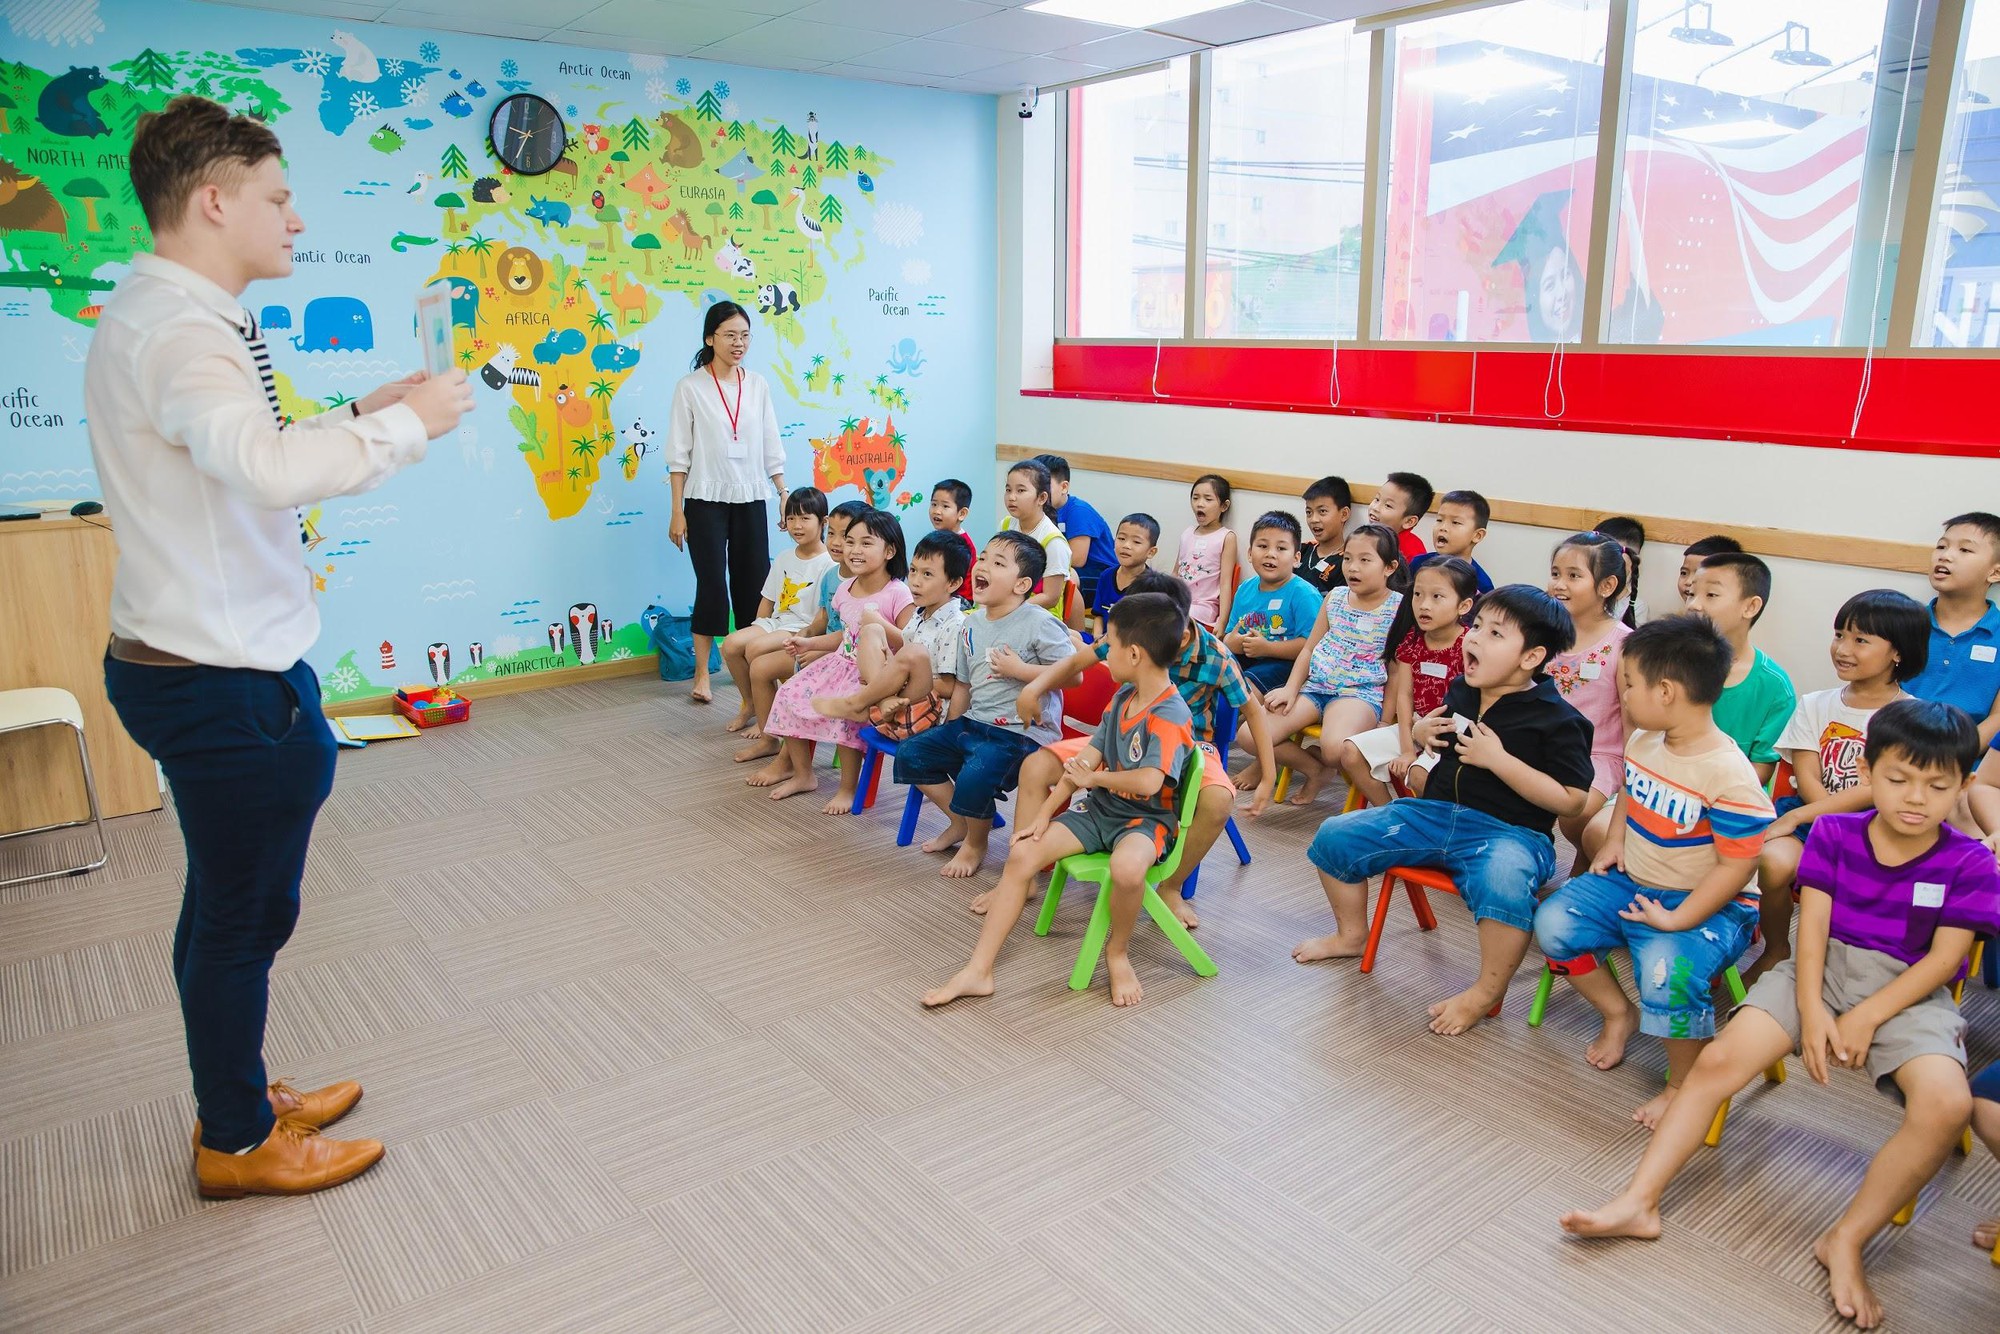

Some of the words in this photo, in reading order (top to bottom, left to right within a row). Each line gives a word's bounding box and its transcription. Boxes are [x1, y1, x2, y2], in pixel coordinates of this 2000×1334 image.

[559, 61, 593, 77] Arctic
[600, 65, 631, 81] Ocean
[27, 147, 86, 168] NORTH
[97, 153, 130, 171] AME
[680, 185, 726, 201] EURASIA
[335, 250, 371, 264] Ocean
[868, 286, 899, 302] Pacific
[882, 303, 910, 316] Ocean
[505, 311, 550, 326] AFRICA
[0, 386, 40, 409] cific
[10, 411, 64, 428] Ocean
[846, 452, 894, 465] AUSTRALIA
[495, 656, 565, 677] ANTARCTICA
